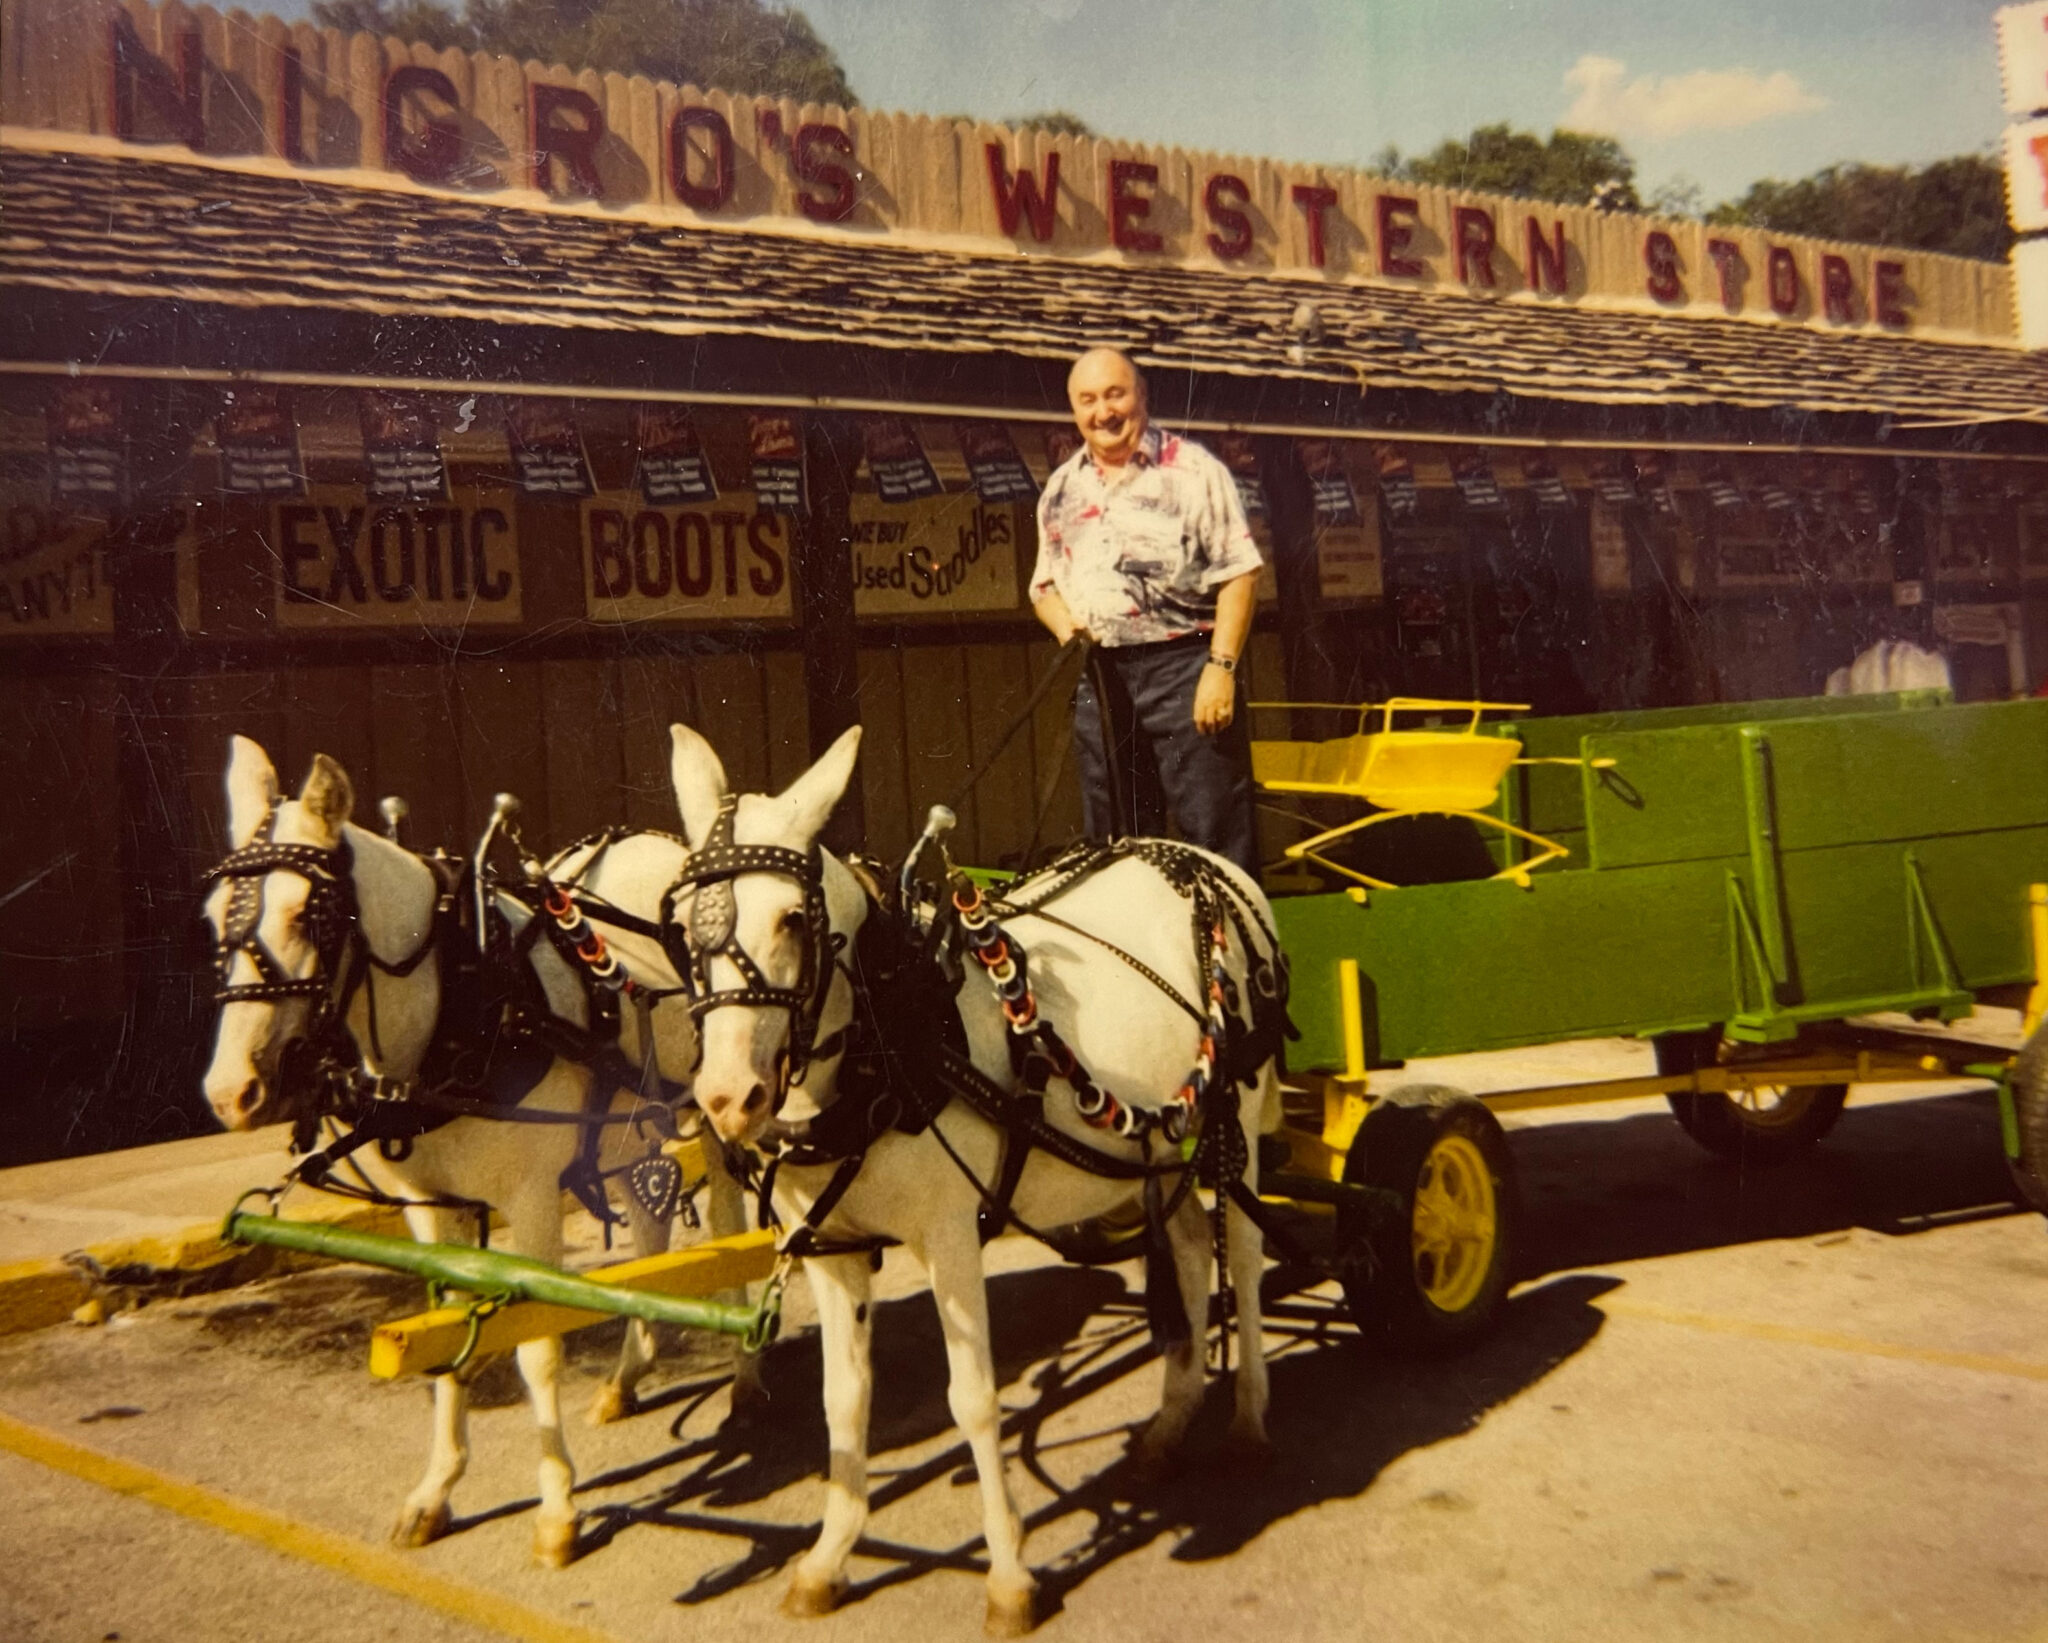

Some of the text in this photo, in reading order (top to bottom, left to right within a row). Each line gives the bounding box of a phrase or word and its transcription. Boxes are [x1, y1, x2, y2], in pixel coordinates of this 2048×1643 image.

[106, 18, 1911, 326] NIGRO'S WESTERN STORE
[279, 506, 513, 603] EXOTIC
[590, 508, 785, 598] BOOTS
[876, 521, 909, 544] BUY
[909, 504, 1010, 598] Saddles
